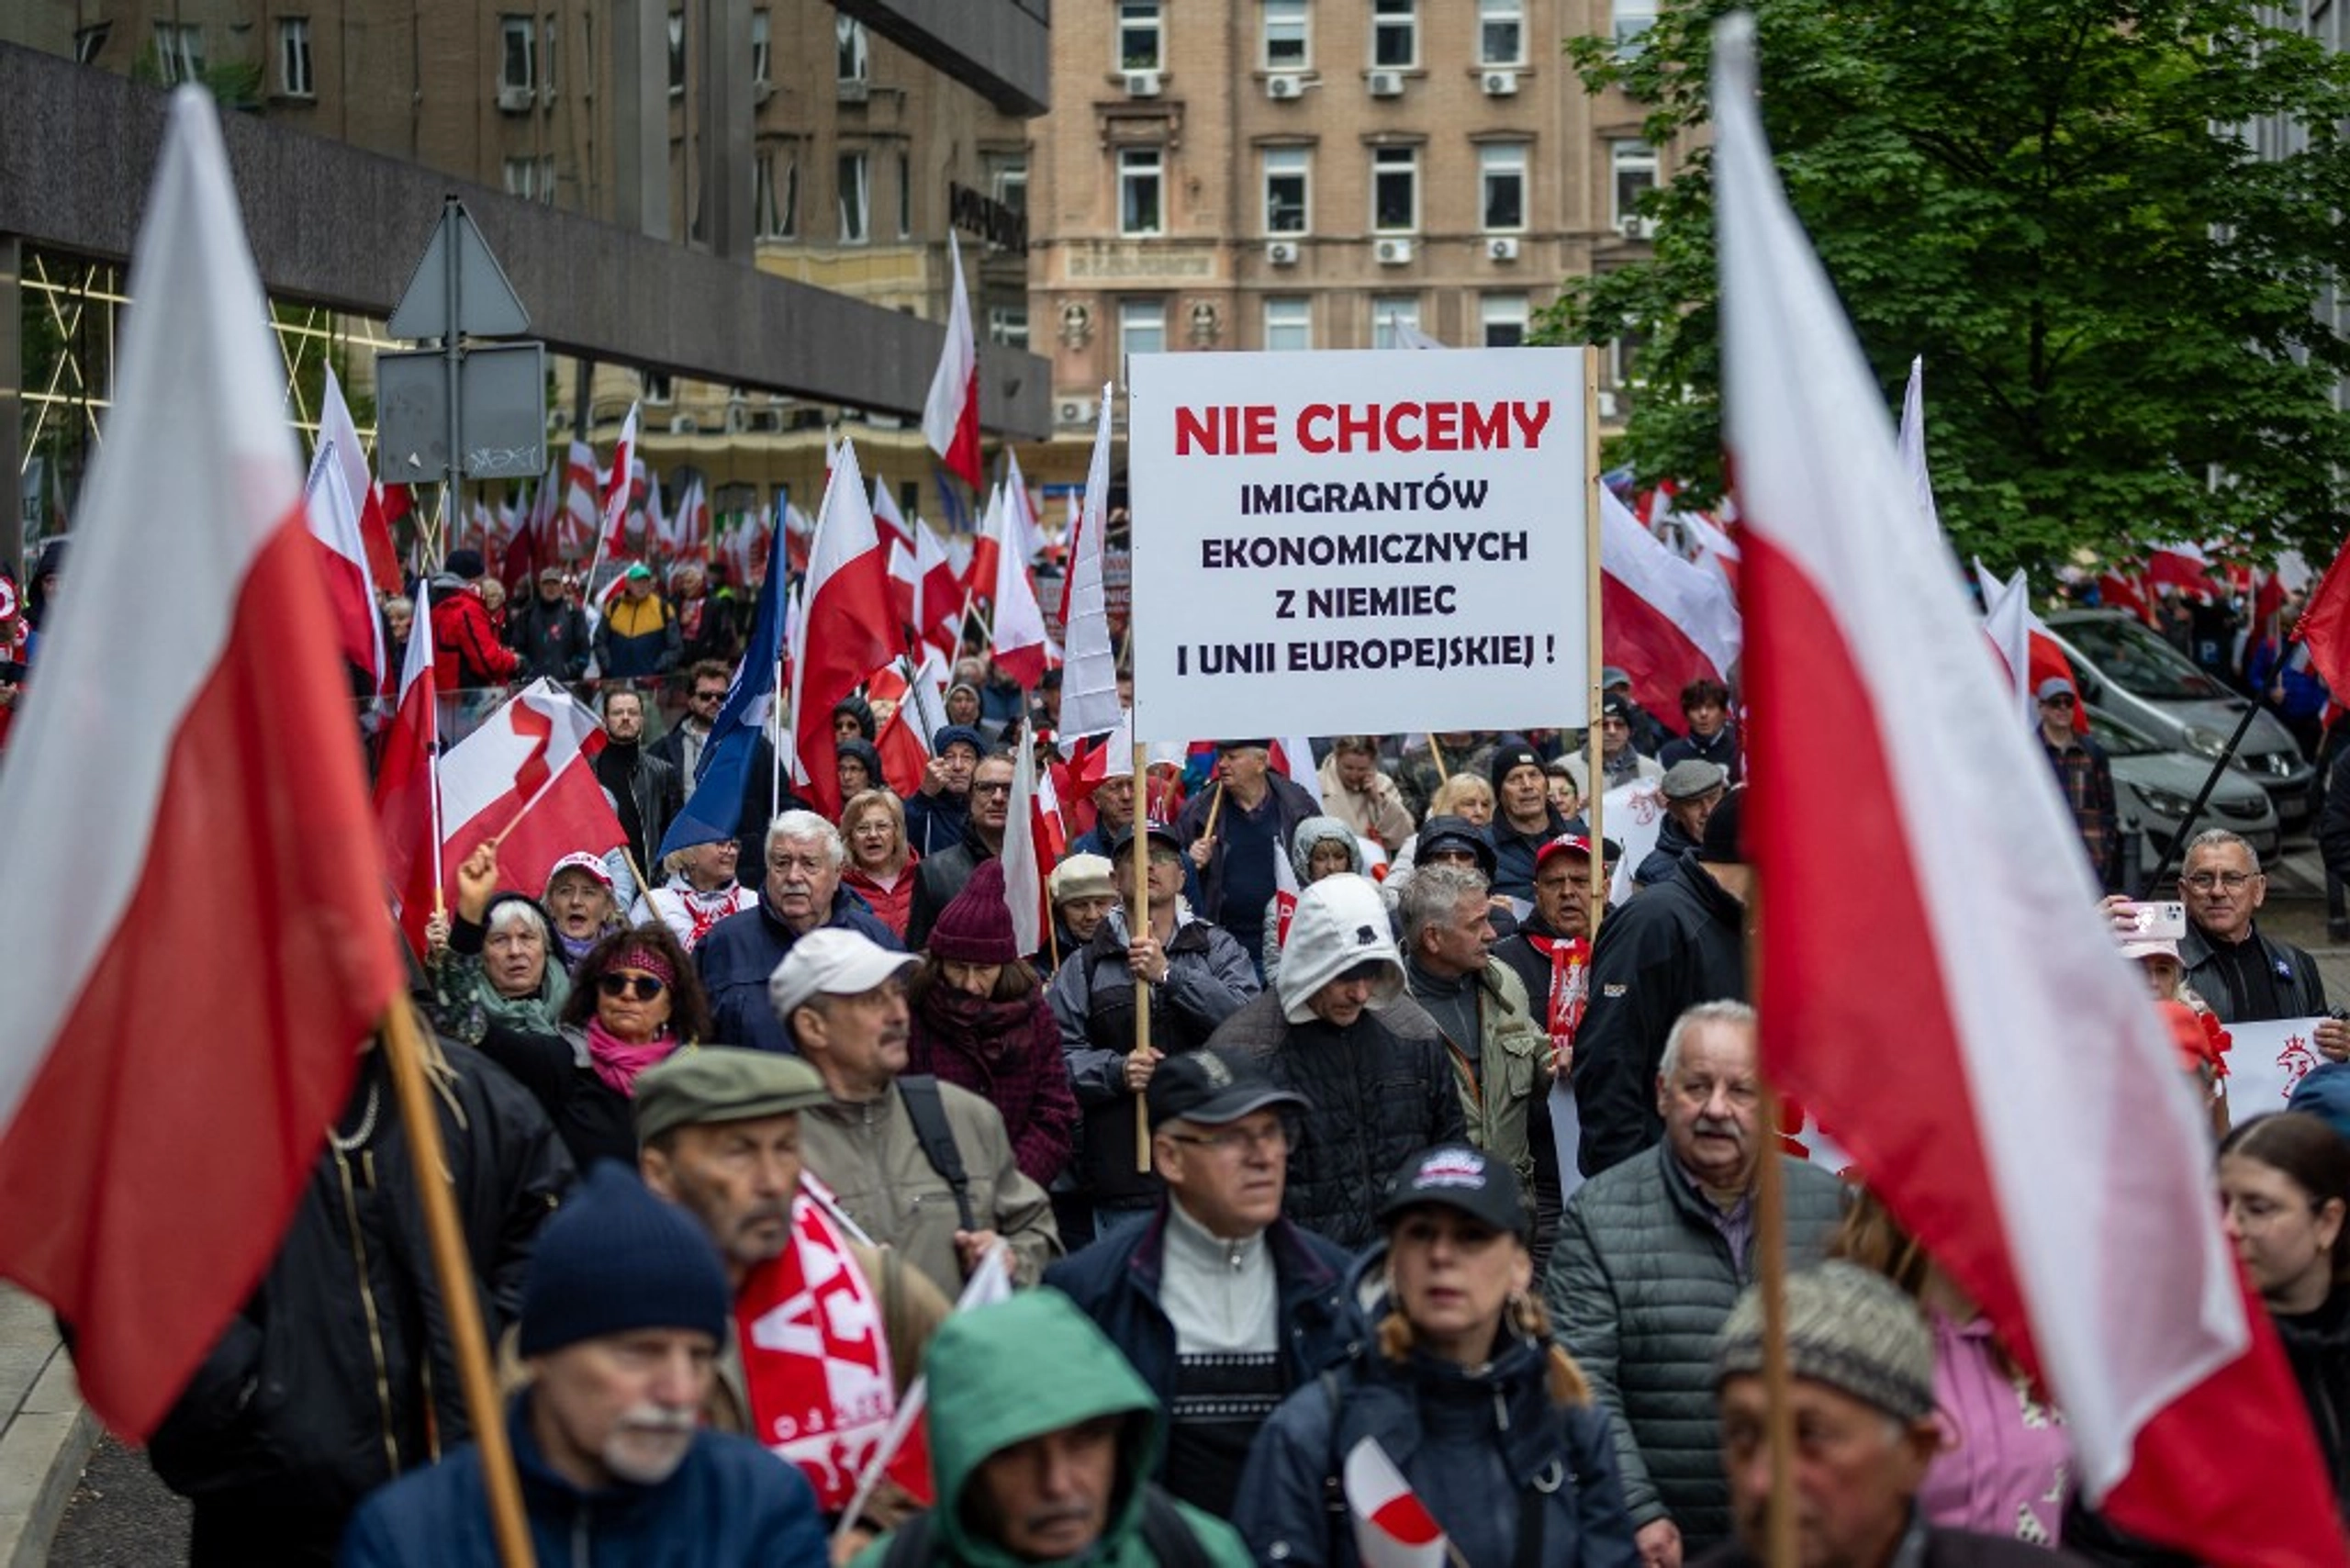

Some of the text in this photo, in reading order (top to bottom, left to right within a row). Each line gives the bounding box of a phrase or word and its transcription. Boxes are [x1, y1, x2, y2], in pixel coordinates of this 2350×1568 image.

[1175, 400, 1550, 456] NIE CHCEMY
[1241, 471, 1489, 515] IMIGRANTÓW
[1202, 530, 1528, 568] EKONOMICZNYCH
[1275, 584, 1457, 619] Z NIEMIEC
[1177, 644, 1188, 677] I
[1198, 642, 1276, 676] UNII
[1287, 634, 1534, 672] EUROPEJSKIEJ
